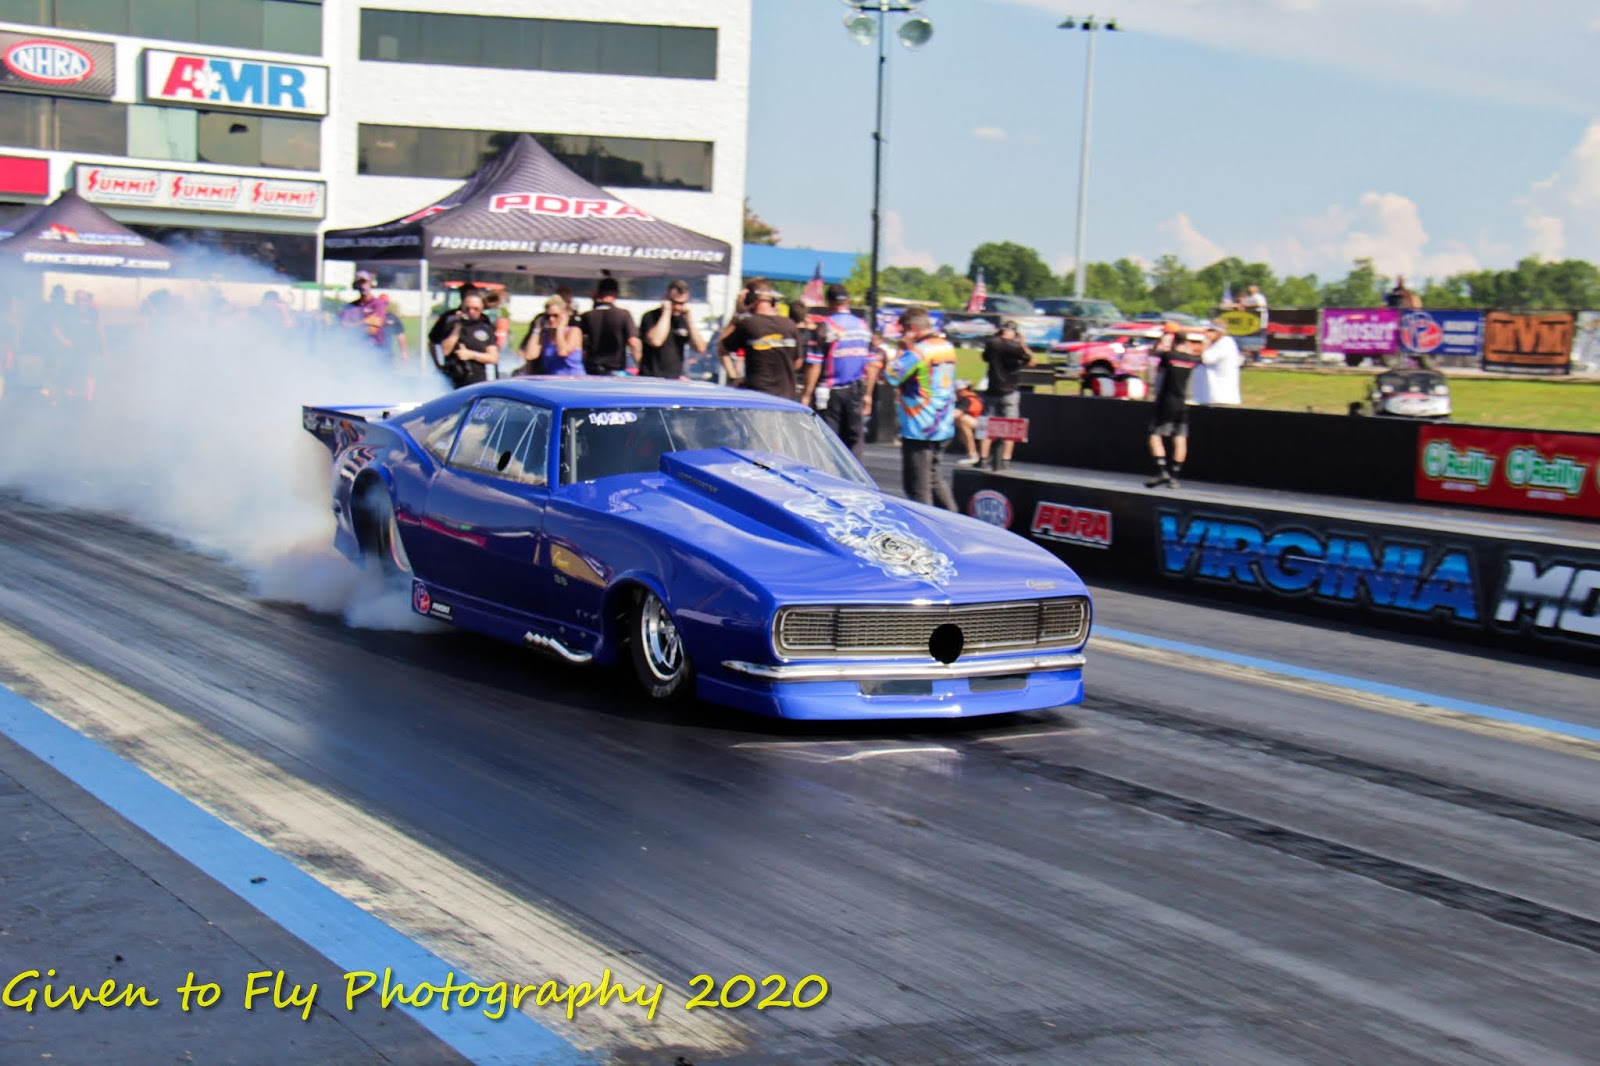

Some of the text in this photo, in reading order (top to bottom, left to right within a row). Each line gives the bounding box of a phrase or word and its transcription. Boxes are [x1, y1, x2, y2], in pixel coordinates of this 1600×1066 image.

[19, 46, 84, 78] NHRA
[162, 56, 307, 108] AMR
[489, 192, 656, 222] PDRA
[431, 236, 537, 254] PROFESSIONAL
[539, 241, 579, 255] DRAG
[579, 243, 632, 258] RACERS
[633, 247, 725, 263] ASSOCIATION
[1033, 503, 1110, 543] PDRA
[1159, 513, 1479, 620] VIRGINIA
